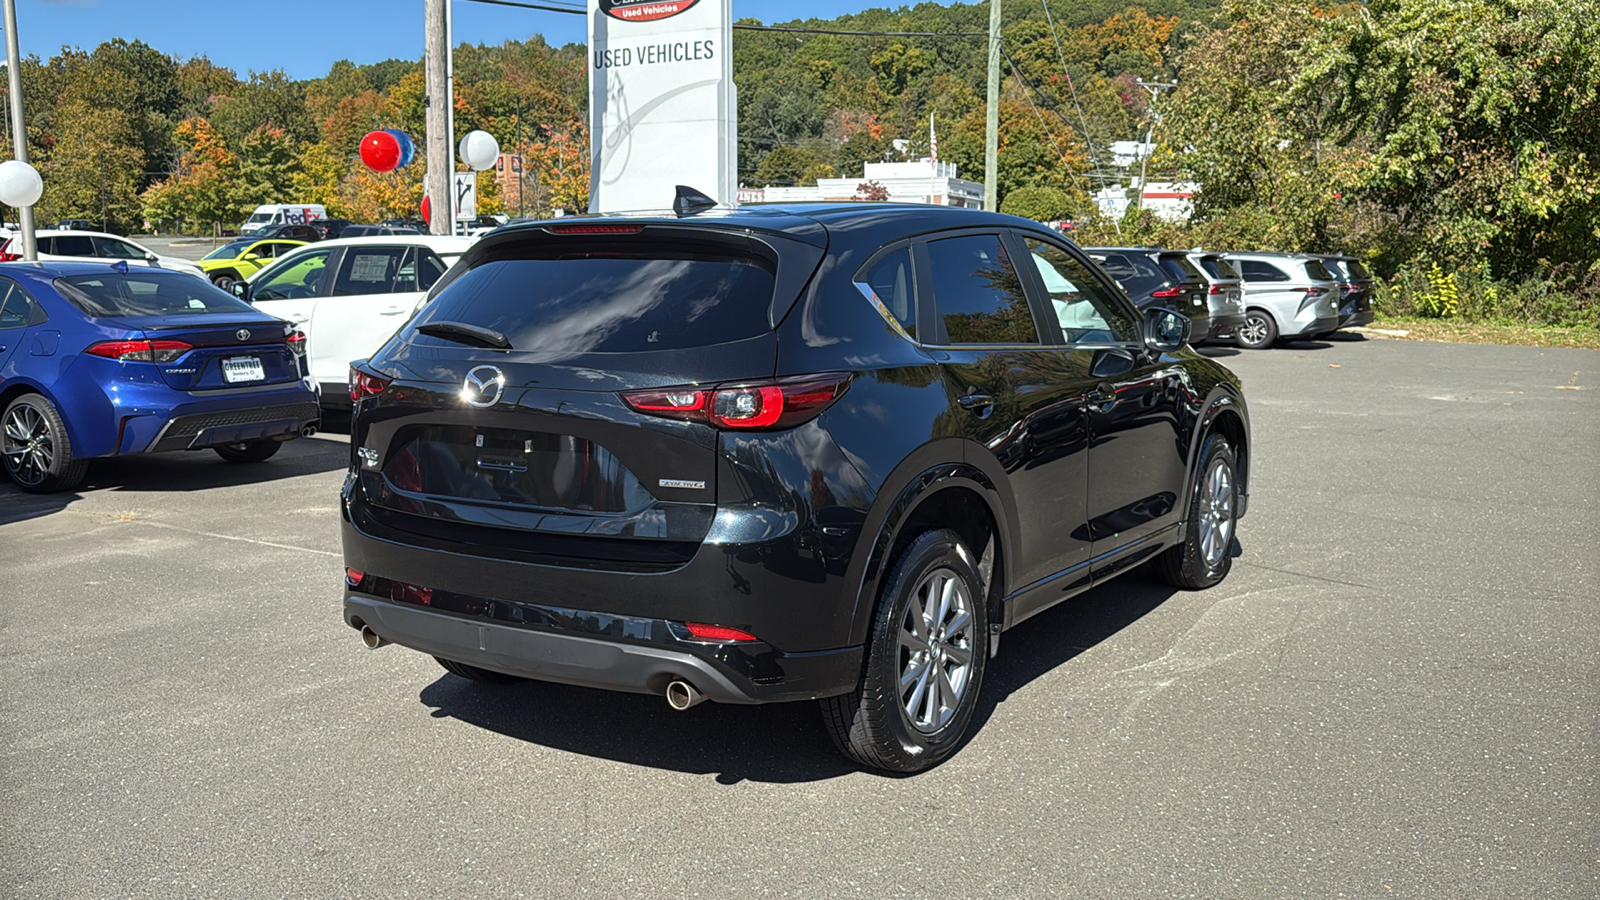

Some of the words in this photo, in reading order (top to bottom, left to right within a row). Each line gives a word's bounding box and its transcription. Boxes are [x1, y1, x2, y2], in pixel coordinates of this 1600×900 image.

[622, 8, 641, 17] Used
[643, 5, 678, 15] Vehicles
[594, 47, 632, 70] USED
[637, 40, 714, 65] VEHICLES
[283, 208, 320, 225] FedEx
[225, 361, 260, 371] GREENTREE
